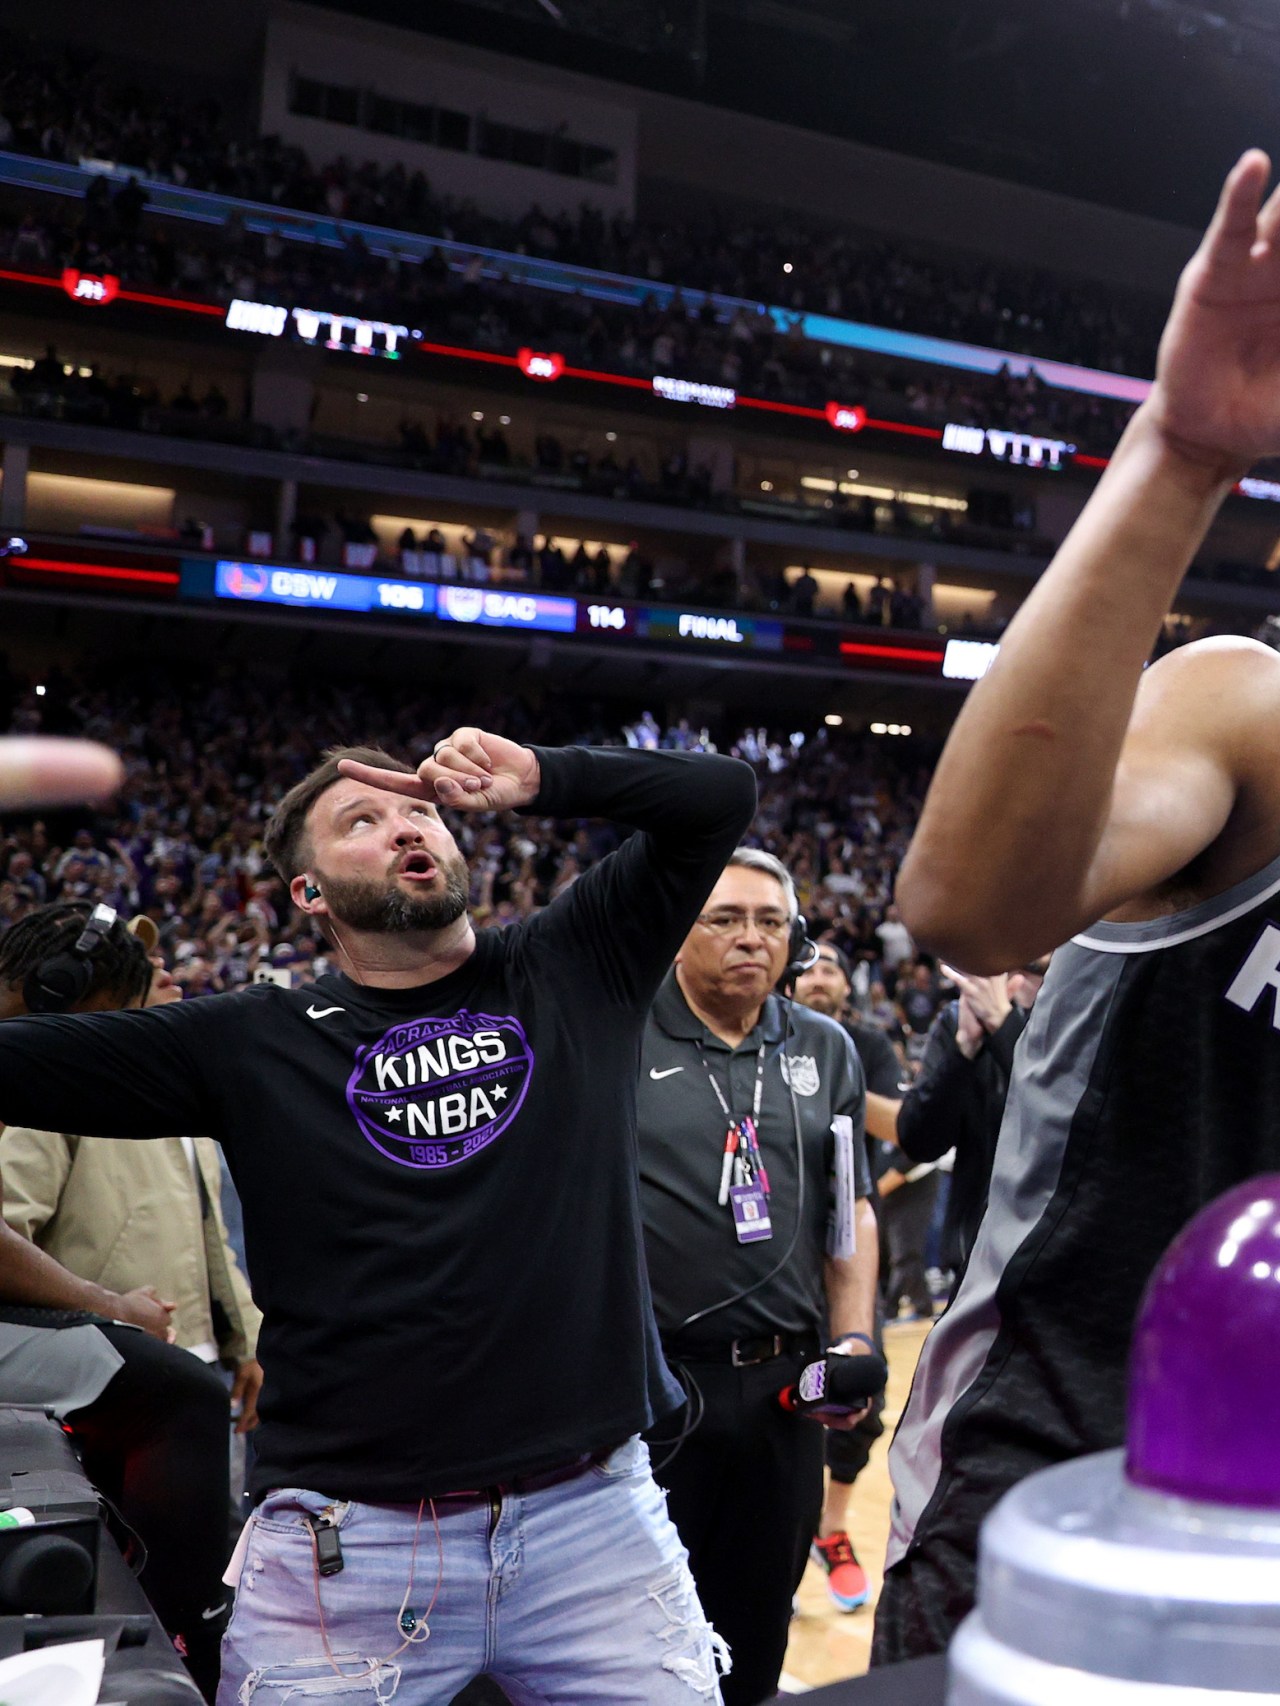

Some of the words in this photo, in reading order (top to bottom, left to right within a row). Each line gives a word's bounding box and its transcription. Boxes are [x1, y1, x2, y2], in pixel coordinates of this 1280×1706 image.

[271, 571, 337, 600] GSW
[485, 594, 536, 621] SAC
[587, 605, 626, 630] 114
[678, 614, 744, 643] FINAL
[375, 1031, 507, 1091] KINGS
[407, 1087, 497, 1136] NBA
[409, 1145, 448, 1164] 1985
